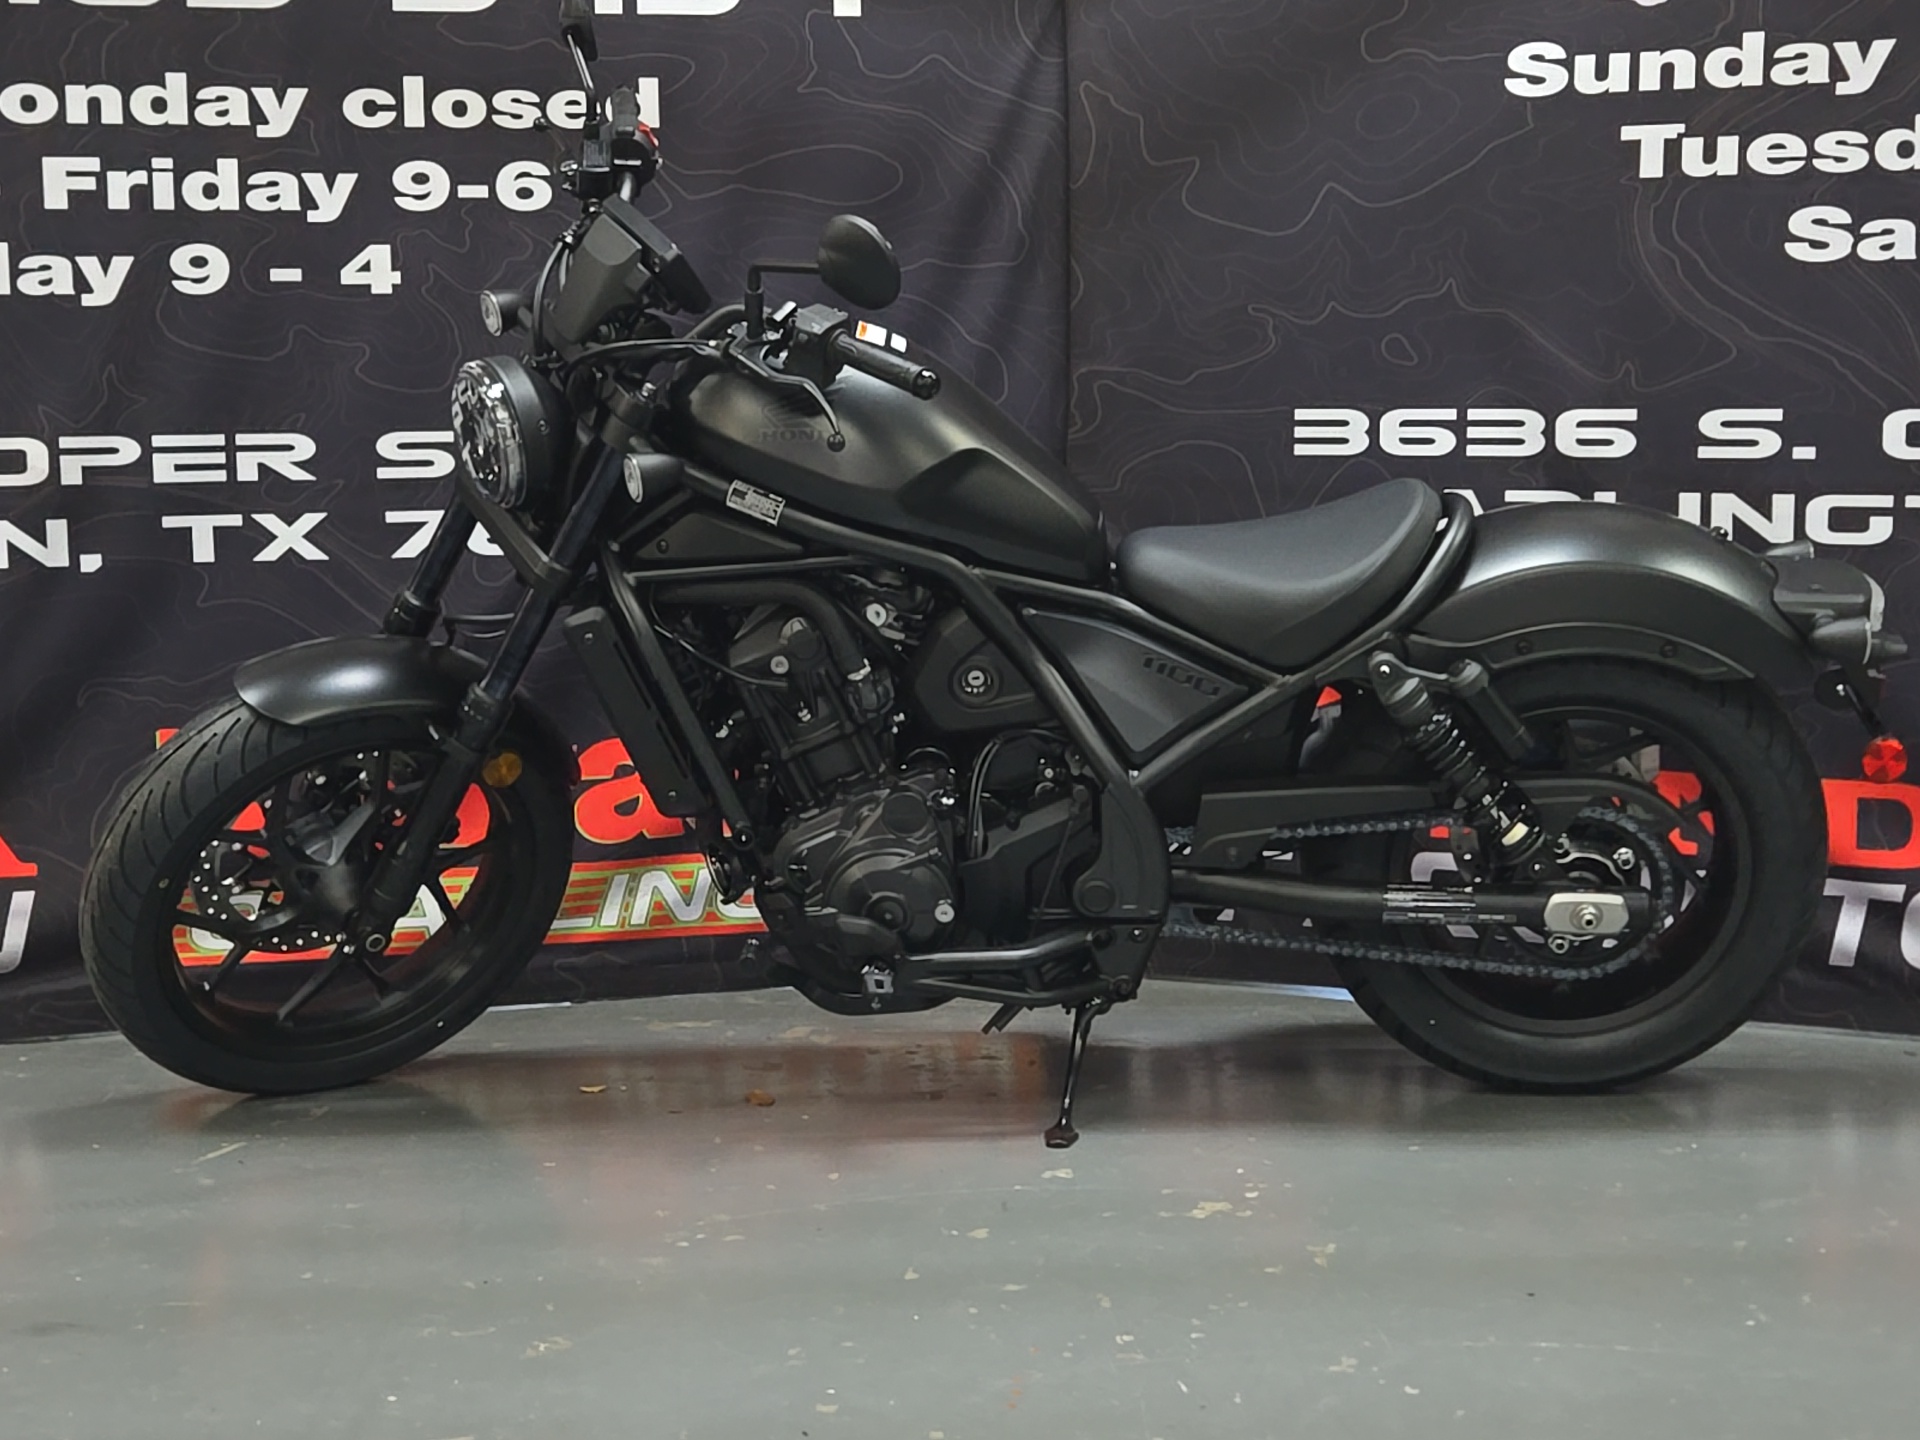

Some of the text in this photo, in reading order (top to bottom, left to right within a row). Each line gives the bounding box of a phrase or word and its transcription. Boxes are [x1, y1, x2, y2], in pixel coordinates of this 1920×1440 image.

[1503, 30, 1897, 98] Sunday
[41, 156, 553, 222] Friday 9-6
[1784, 205, 1917, 263] Sa
[169, 243, 230, 295] 9
[340, 244, 402, 295] 4
[1293, 408, 1817, 460] 3636 S.
[161, 512, 330, 563] TX
